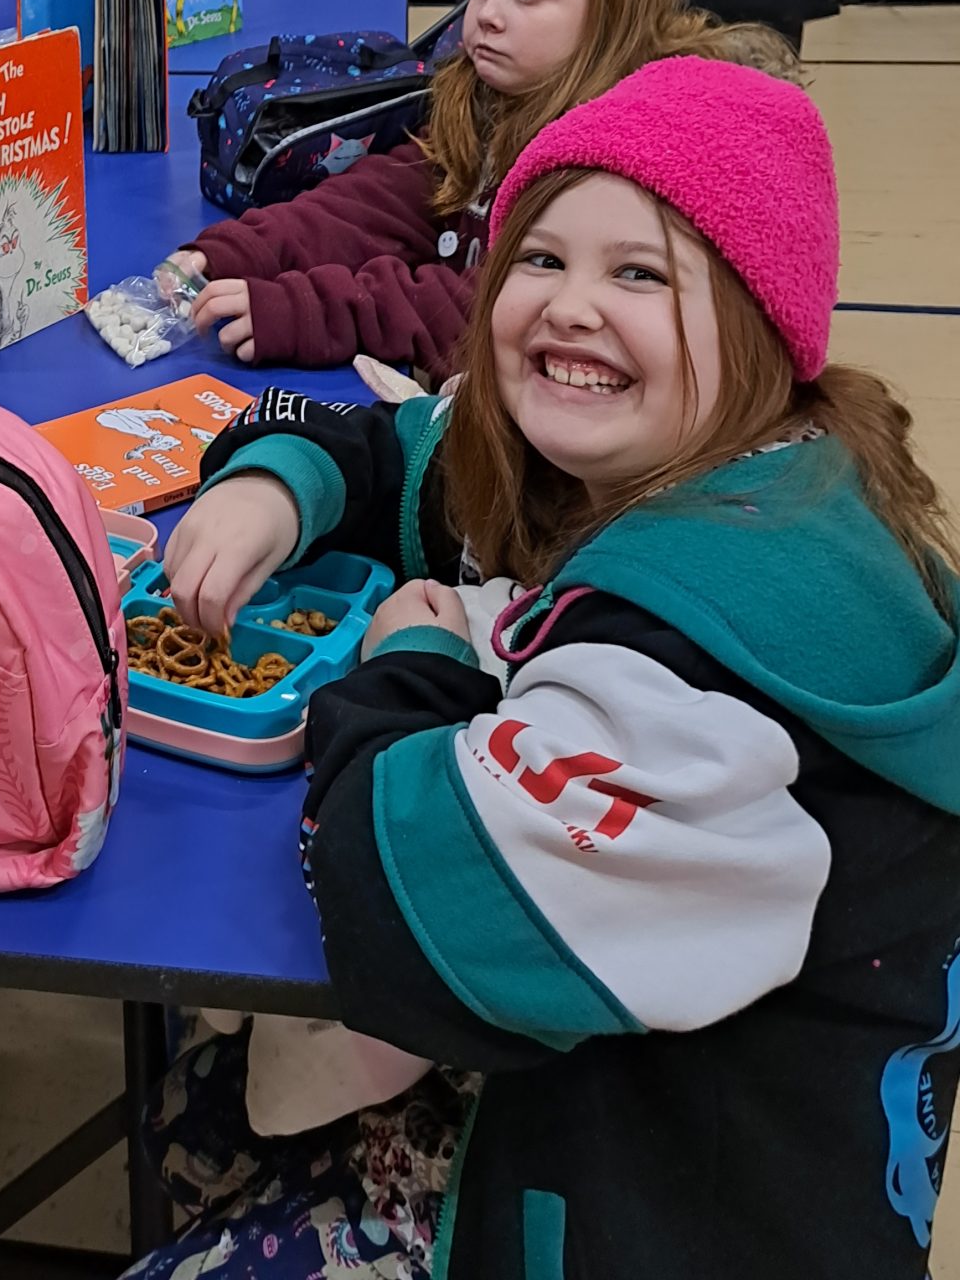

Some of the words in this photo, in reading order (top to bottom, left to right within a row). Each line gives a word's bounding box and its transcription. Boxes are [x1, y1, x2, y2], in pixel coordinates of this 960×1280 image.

[200, 9, 223, 26] Seuss
[0, 59, 25, 82] The
[25, 276, 44, 297] Dr.
[44, 266, 73, 289] Seuss
[194, 390, 242, 420] Seuss
[73, 462, 116, 491] Eggs
[122, 465, 161, 487] and
[150, 452, 191, 479] Ham
